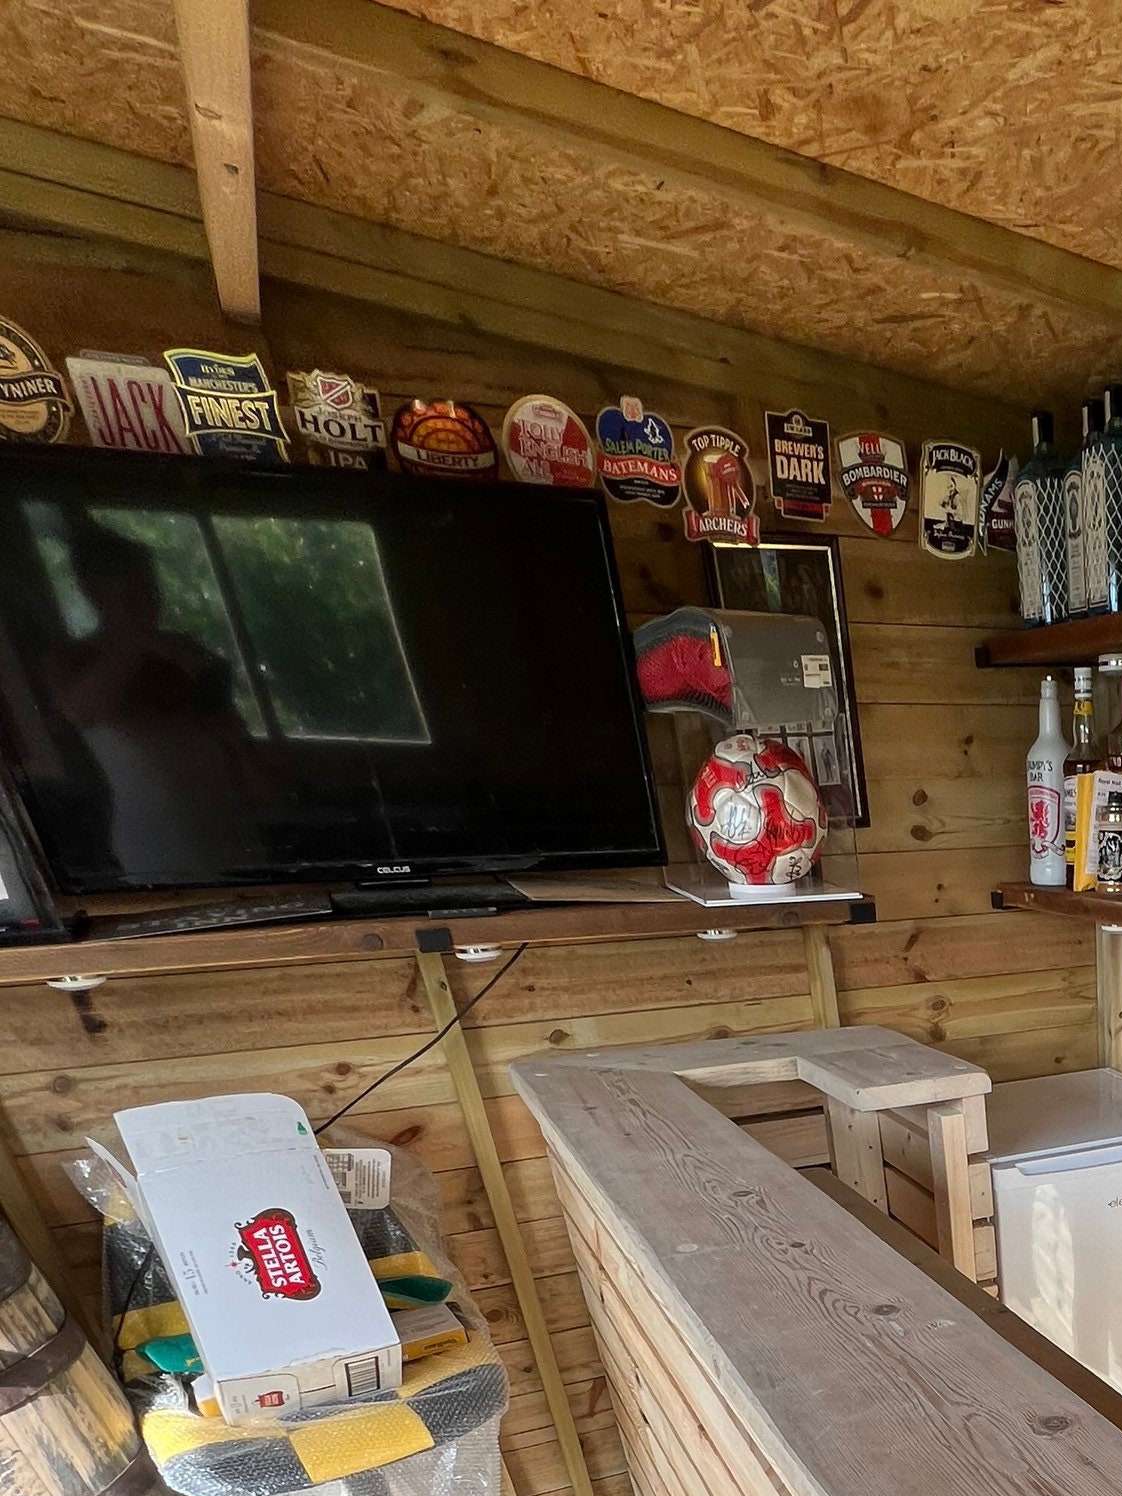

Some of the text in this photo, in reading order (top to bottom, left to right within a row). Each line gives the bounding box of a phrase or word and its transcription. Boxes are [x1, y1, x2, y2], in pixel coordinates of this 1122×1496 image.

[0, 377, 58, 399] YNINER
[90, 376, 183, 453] JACK
[187, 395, 272, 431] FINEST
[298, 409, 382, 442] HOLT
[518, 437, 588, 468] ENGLISH
[692, 434, 741, 458] TOP TIPPLE
[774, 439, 824, 460] BREWER'S
[328, 450, 368, 471] IPA
[416, 449, 480, 468] LIBERTY
[603, 459, 678, 481] BATEMANS
[776, 455, 826, 485] DARK
[932, 448, 974, 471] JACK BLACK
[842, 466, 908, 487] BOMBARDIER
[699, 517, 749, 536] ARCHERS
[1030, 772, 1044, 782] BAR
[377, 866, 411, 874] CELCUS
[253, 1227, 288, 1288] STELLA
[269, 1224, 306, 1285] ARTOIS
[306, 1229, 328, 1271] Belgium
